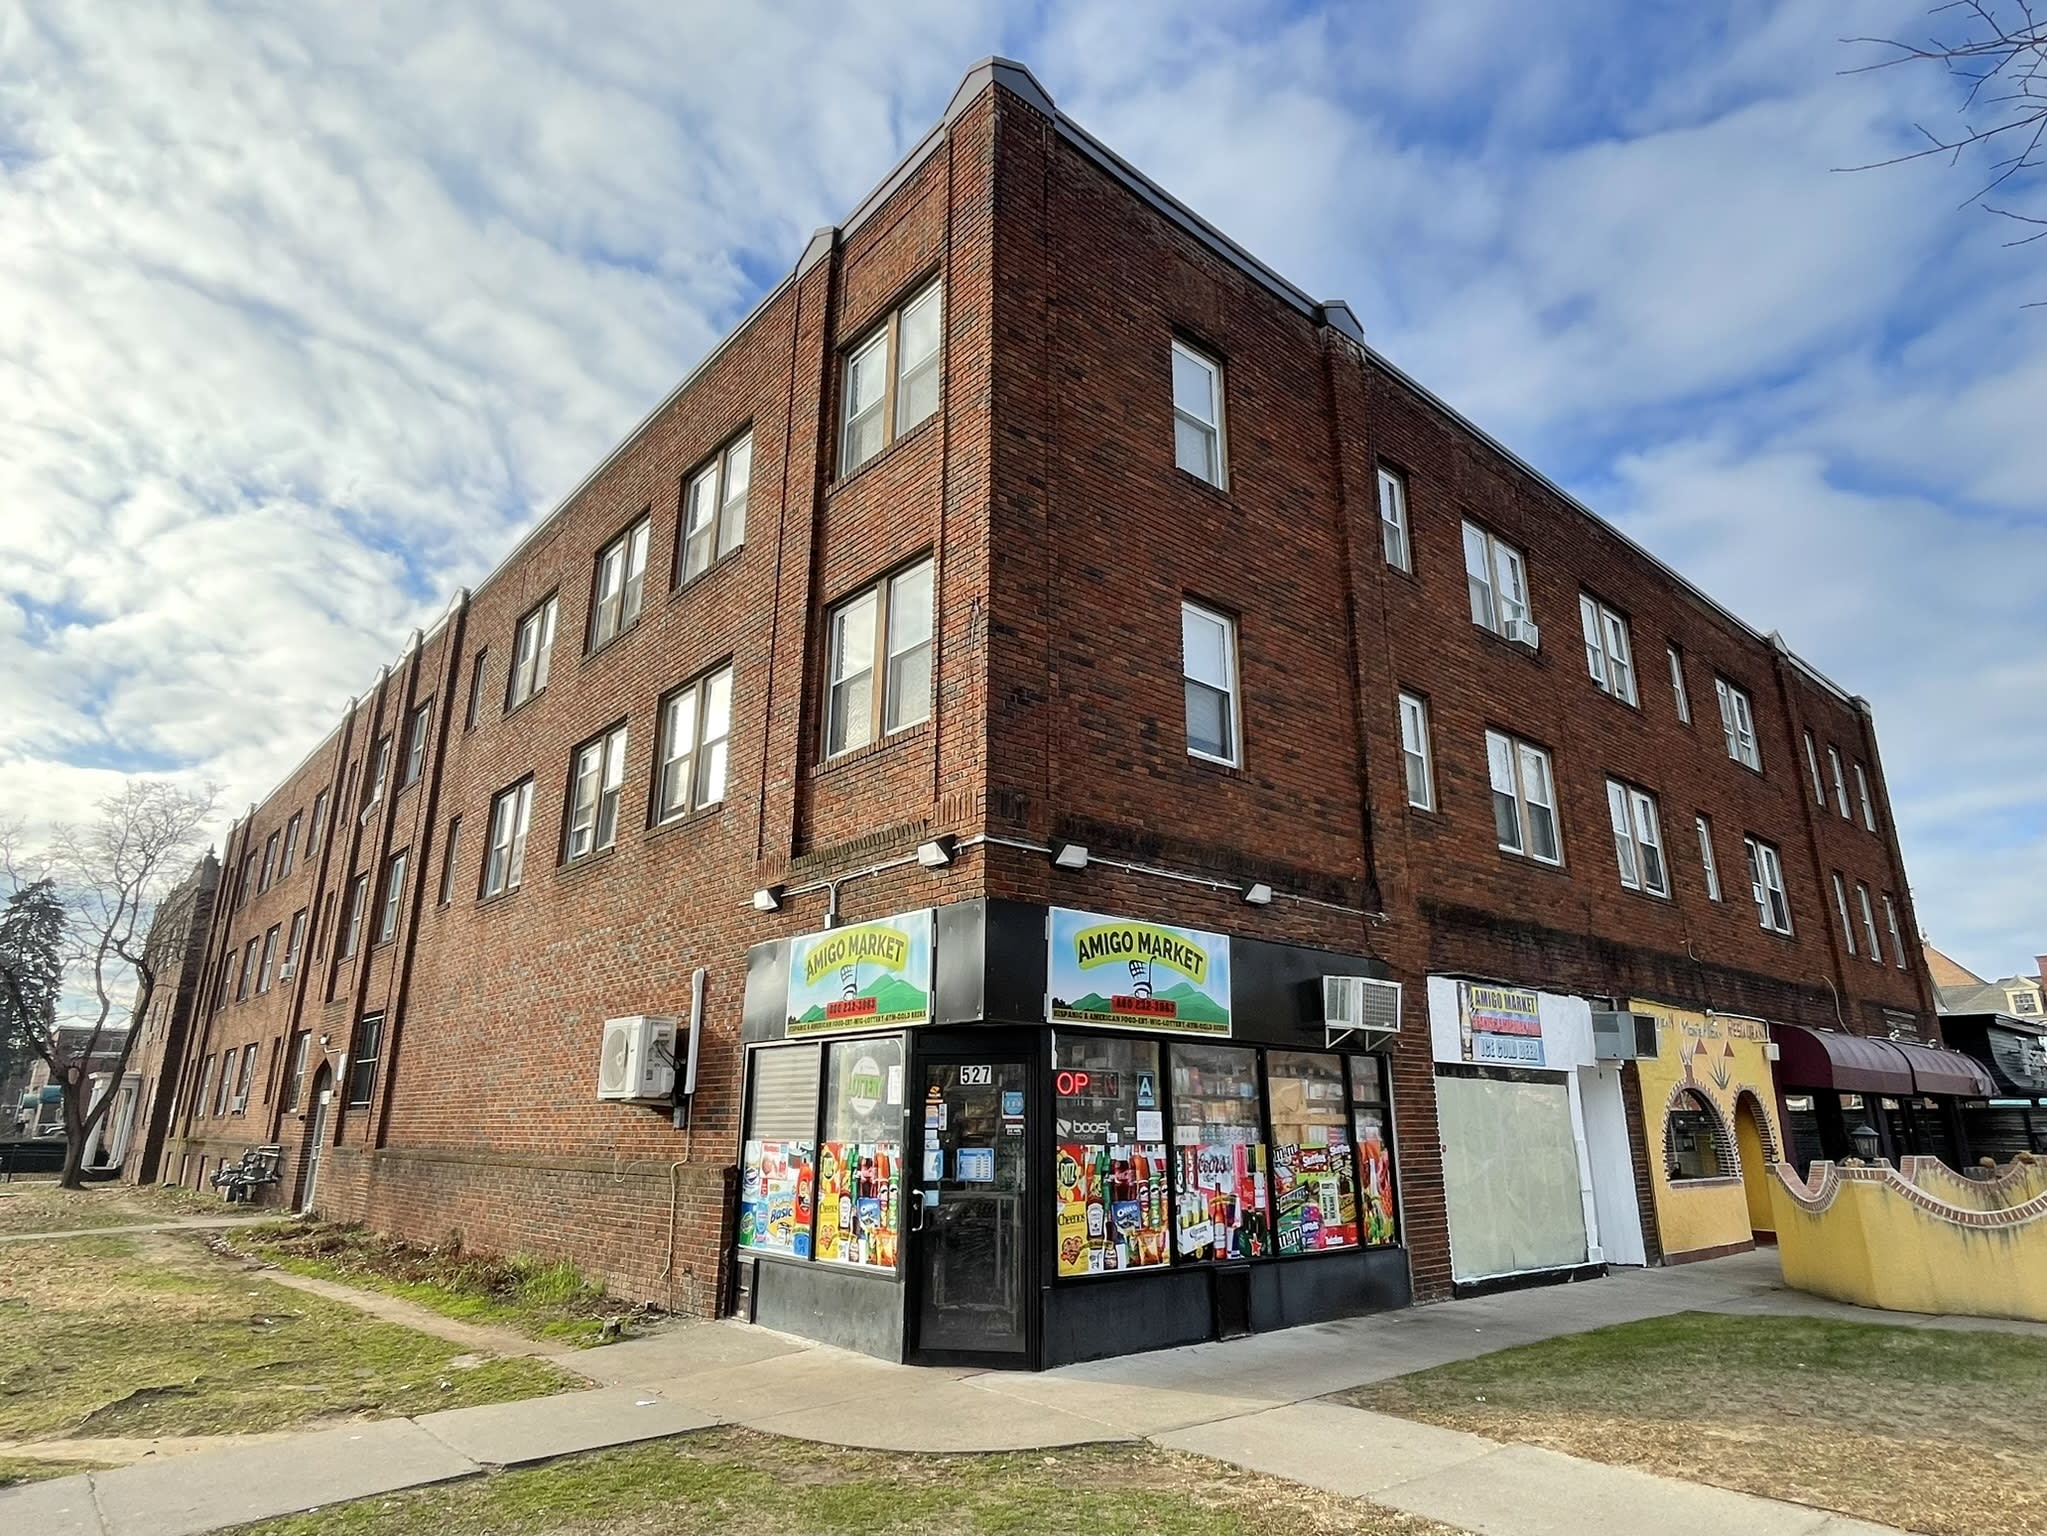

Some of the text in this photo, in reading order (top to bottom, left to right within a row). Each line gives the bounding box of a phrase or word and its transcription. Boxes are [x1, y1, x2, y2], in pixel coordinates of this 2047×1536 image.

[807, 933, 904, 981] AMIGO MARKET
[1078, 930, 1203, 974] AMIGO MARKET
[1475, 989, 1536, 1014] AMIGO MARKET
[1089, 1012, 1120, 1022] AMERICAN
[962, 1066, 990, 1084] 527
[1139, 1077, 1152, 1097] A
[1073, 1120, 1111, 1134] boost
[769, 1207, 793, 1224] Basic
